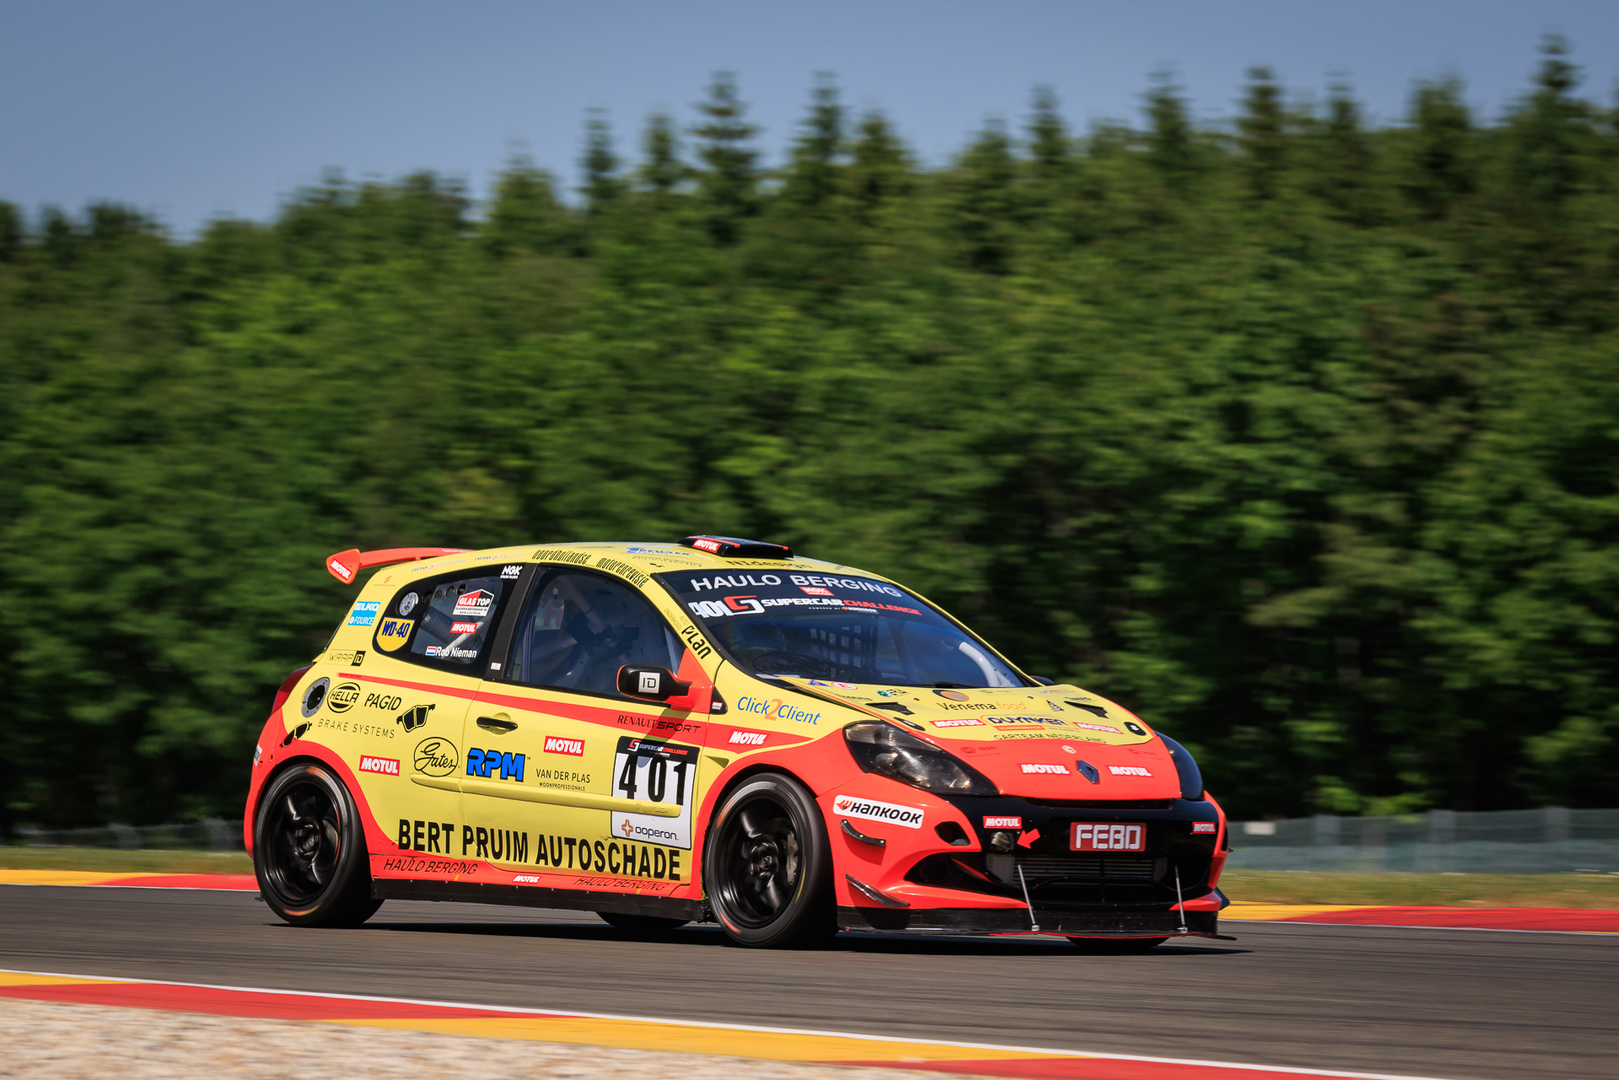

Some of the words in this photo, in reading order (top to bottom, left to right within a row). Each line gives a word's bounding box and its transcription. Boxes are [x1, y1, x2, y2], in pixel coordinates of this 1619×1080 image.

[694, 539, 718, 551] MOTUL
[330, 559, 352, 579] MOTUL
[501, 565, 523, 576] NGK
[690, 574, 782, 592] HAULO
[789, 574, 902, 598] BERGING
[361, 603, 380, 611] LKQ
[459, 597, 477, 606] GLAS
[477, 598, 491, 606] TOP
[761, 598, 844, 606] SUPERCAR
[843, 599, 923, 616] CHALLENGE
[687, 600, 734, 618] 401
[381, 620, 411, 638] WD-40
[451, 623, 476, 632] MOTUL
[329, 653, 354, 662] WRAP
[435, 646, 450, 657] Rob
[451, 647, 477, 658] Nieman
[642, 677, 656, 688] ID
[331, 691, 360, 703] HELLA
[364, 692, 402, 711] PAGID
[737, 696, 821, 726] Click2Client
[938, 703, 997, 711] Venema
[996, 701, 1027, 711] food
[617, 714, 656, 730] RENAULT
[656, 721, 701, 734] SPORT
[934, 720, 984, 728] MOTUL
[987, 716, 1068, 726] DUYNKER
[317, 718, 349, 732] BRAKE
[352, 725, 395, 740] SYSTEMS
[728, 731, 767, 745] MOTUL
[993, 733, 1043, 741] CARTEAM
[1045, 733, 1107, 744] NEDERLAND
[545, 738, 583, 754] MOTUL
[413, 742, 456, 772] Gates
[361, 757, 398, 774] MOTUL
[466, 747, 526, 783] RPM
[1021, 764, 1070, 775] MOTUL
[1108, 766, 1152, 777] MOTUL
[535, 768, 552, 779] VAN
[553, 770, 570, 781] DER
[571, 772, 591, 784] PLAS
[618, 753, 688, 806] 401
[984, 818, 1021, 827] MOTUL
[1193, 823, 1216, 832] MOTUL
[1075, 824, 1142, 850] FEBO
[398, 818, 455, 852] BERT
[461, 824, 529, 864] PRUIM
[534, 833, 682, 882] AUTOSCHADE
[383, 858, 426, 873] HAULO
[424, 861, 479, 875] BERGING
[513, 875, 540, 884] MOTUL
